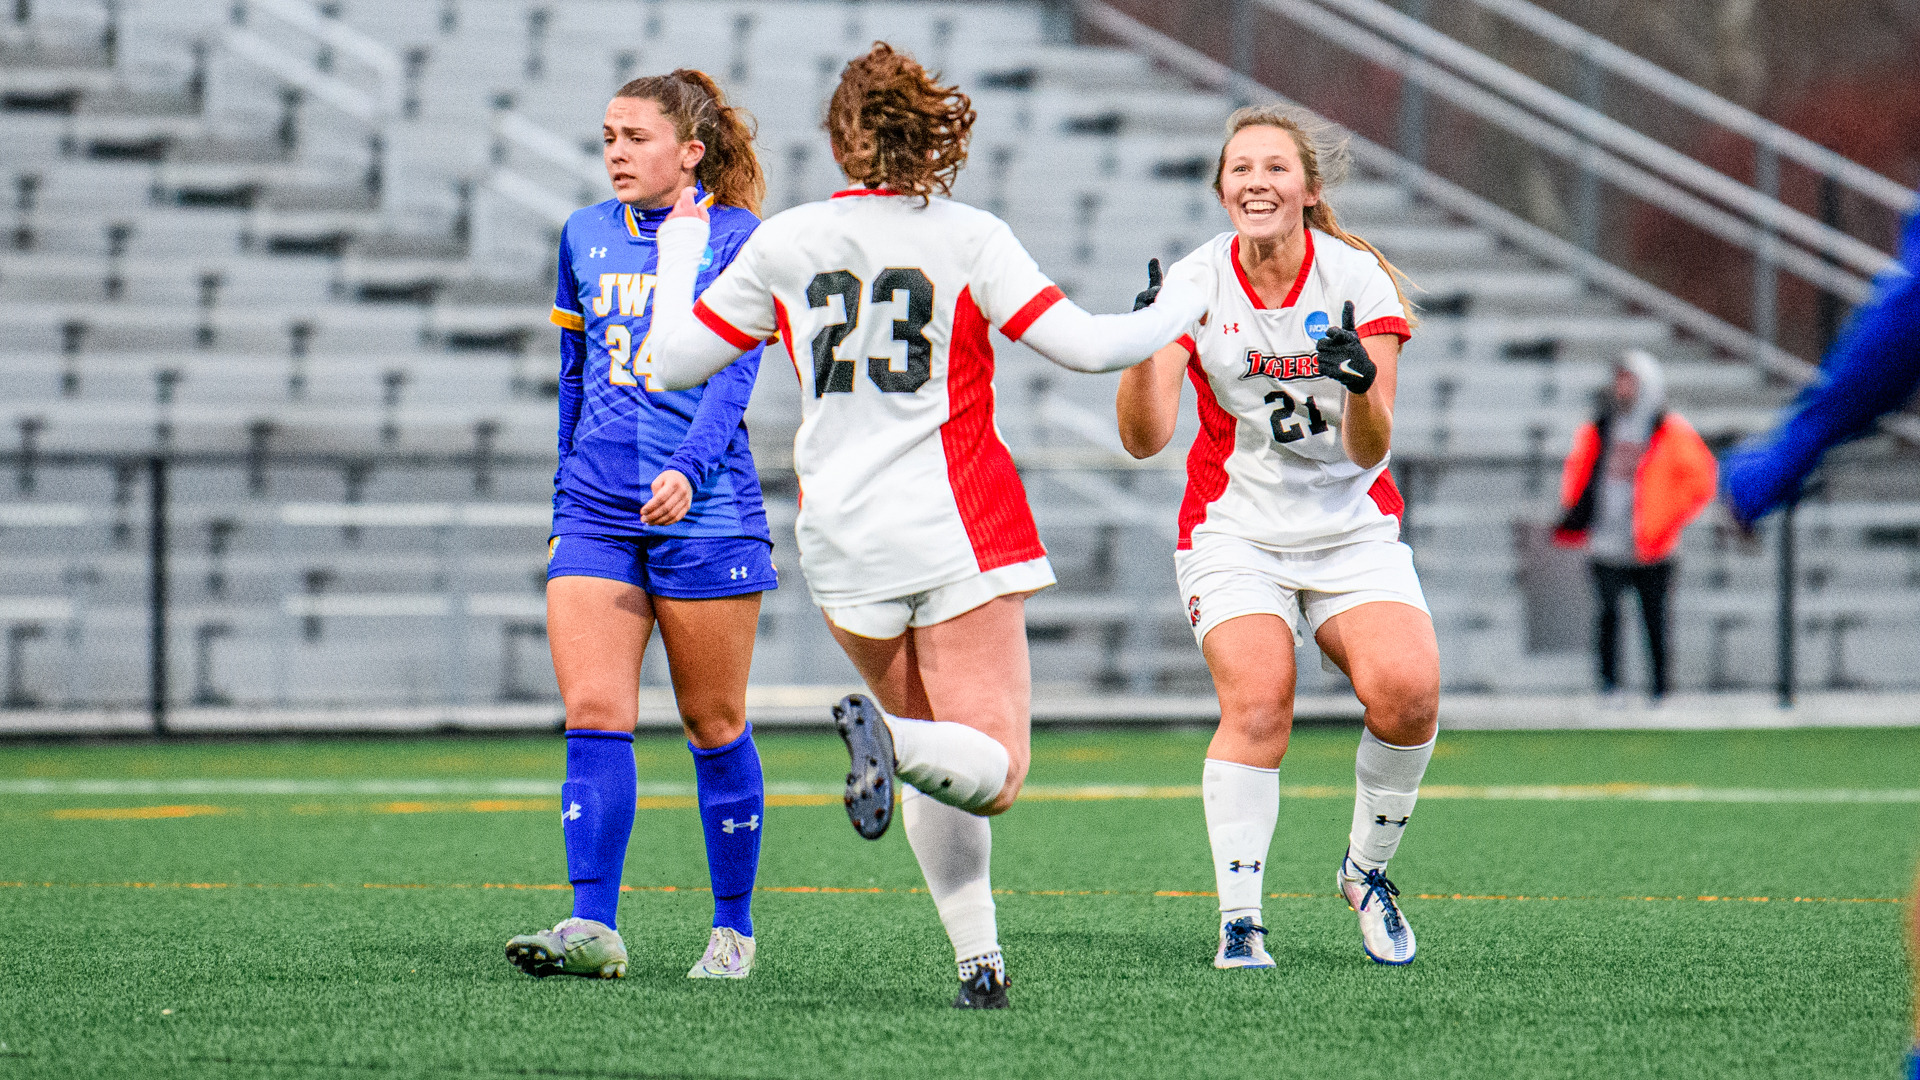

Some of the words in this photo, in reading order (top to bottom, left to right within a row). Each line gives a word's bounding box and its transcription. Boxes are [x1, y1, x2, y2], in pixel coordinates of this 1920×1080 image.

[605, 325, 664, 391] 24
[806, 267, 935, 399] 23
[1264, 391, 1329, 443] 21
